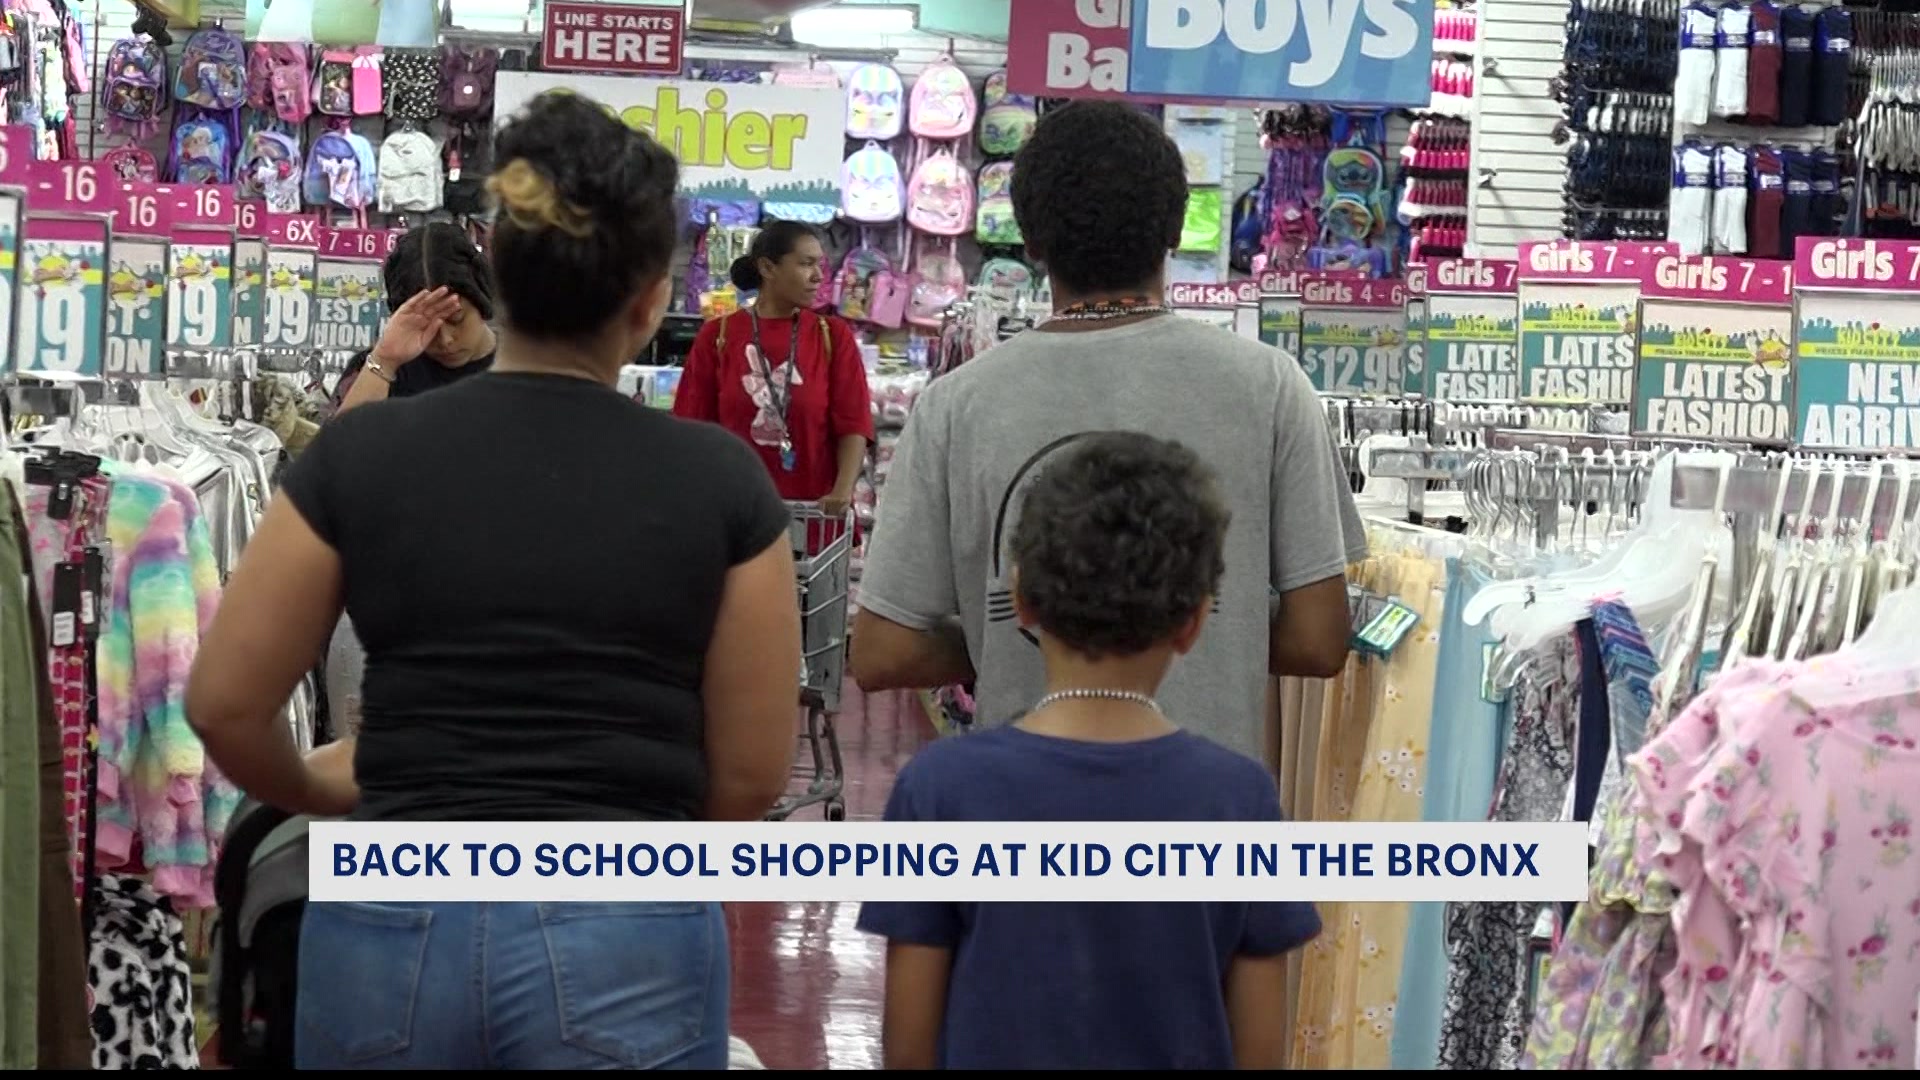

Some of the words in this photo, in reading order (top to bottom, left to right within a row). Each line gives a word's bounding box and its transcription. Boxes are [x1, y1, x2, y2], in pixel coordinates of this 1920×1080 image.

[554, 11, 598, 27] LINE
[601, 14, 674, 31] STARTS
[555, 30, 671, 65] HERE
[1146, 0, 1419, 87] Boys
[545, 85, 807, 170] hier
[61, 165, 96, 202] 16
[128, 196, 157, 227] 16
[194, 189, 221, 217] 16
[286, 220, 315, 242] 6X
[328, 232, 340, 250] 7
[356, 234, 376, 254] 16
[1530, 241, 1594, 272] Girls
[1602, 246, 1618, 273] 7
[1811, 238, 1895, 281] Girls
[1261, 271, 1298, 293] Girl
[1437, 259, 1496, 288] Girls
[1504, 264, 1518, 287] 7
[1655, 255, 1728, 292] Girls
[1739, 262, 1756, 293] 7
[1173, 285, 1204, 303] Girl
[1304, 280, 1353, 303] Girls
[1360, 284, 1373, 303] 4
[1391, 284, 1406, 305] 6
[1447, 342, 1516, 371] LATE
[1543, 333, 1635, 368] LATES
[1663, 361, 1790, 402] LATEST
[1647, 399, 1790, 440] FASHION
